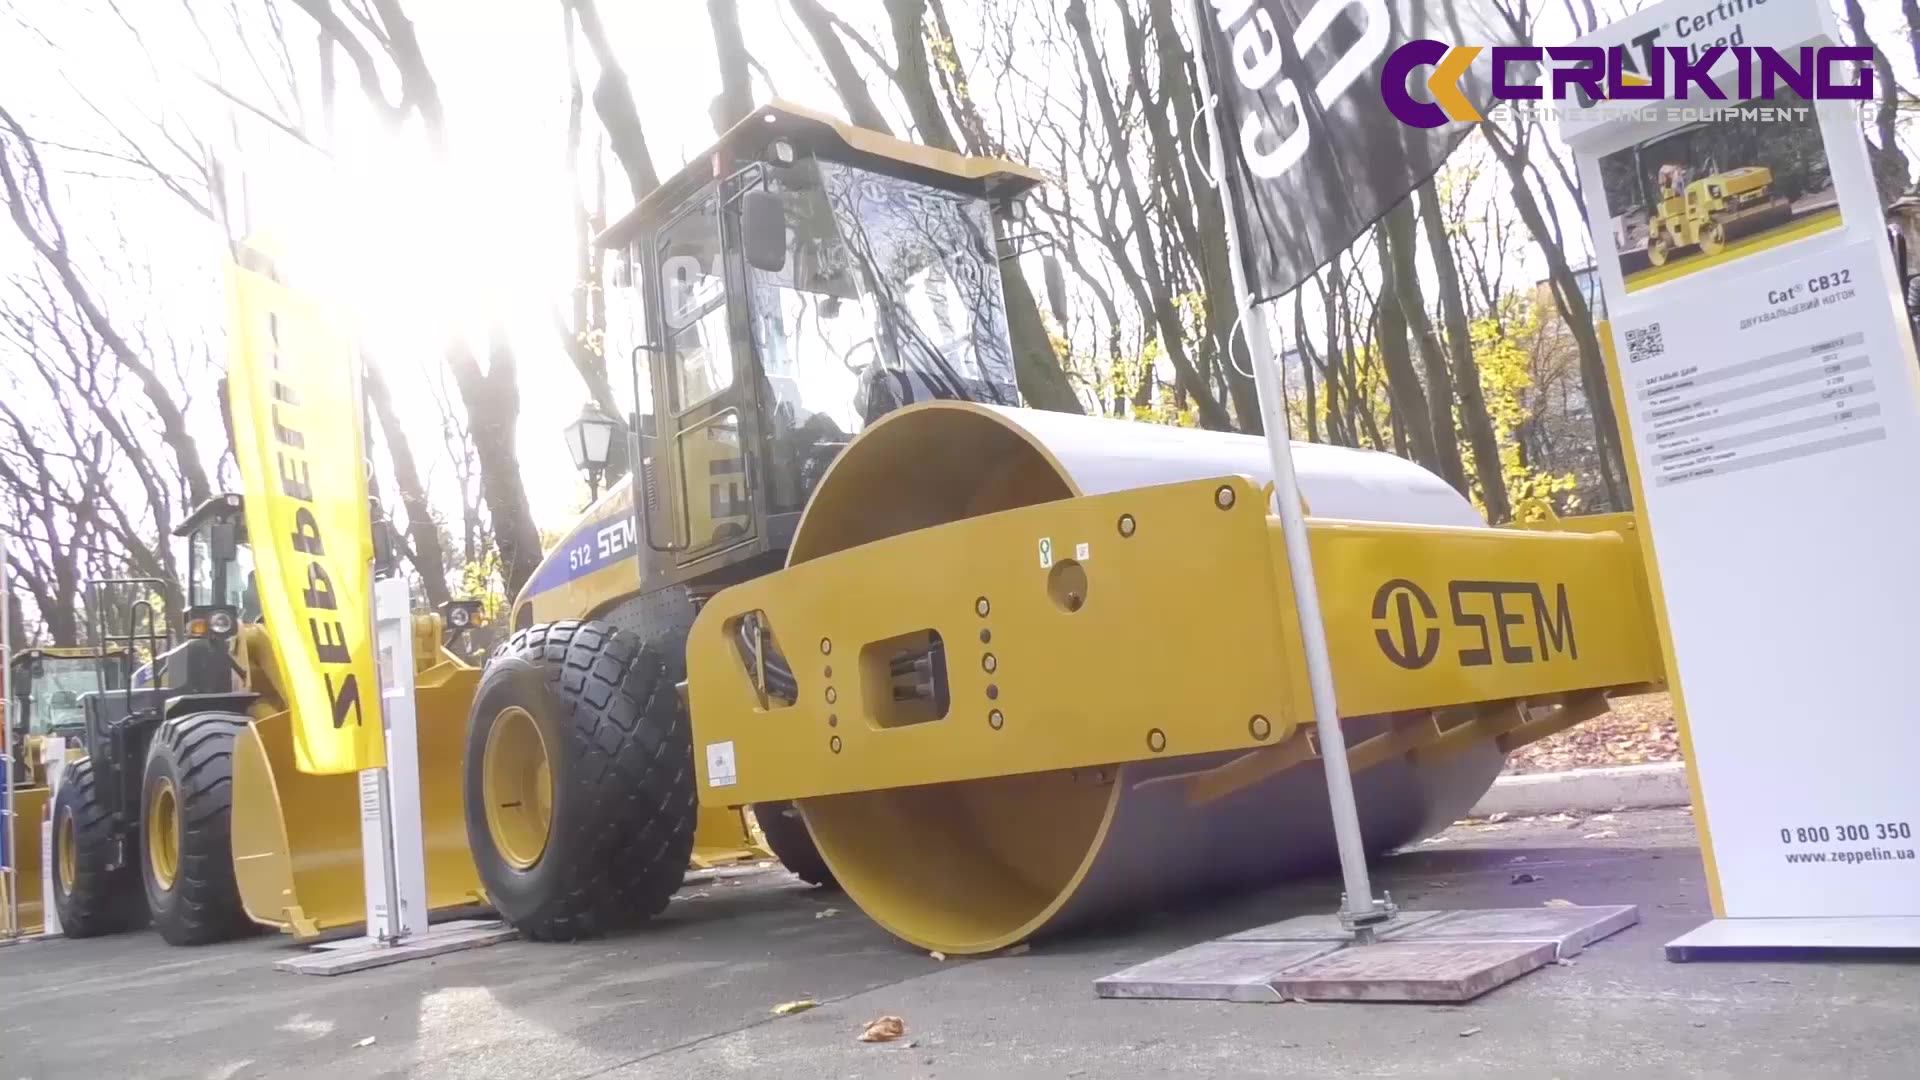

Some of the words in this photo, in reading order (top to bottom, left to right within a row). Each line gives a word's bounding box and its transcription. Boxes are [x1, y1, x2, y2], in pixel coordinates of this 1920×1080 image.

[1808, 269, 1851, 293] CB32
[570, 543, 592, 570] 512
[597, 515, 637, 559] SEM
[1448, 580, 1577, 667] SEM
[1781, 828, 1791, 844] 0
[1797, 826, 1830, 843] 800
[1835, 824, 1870, 841] 300
[1875, 822, 1911, 839] 350
[1785, 847, 1915, 864] www.zeppelin.ua
